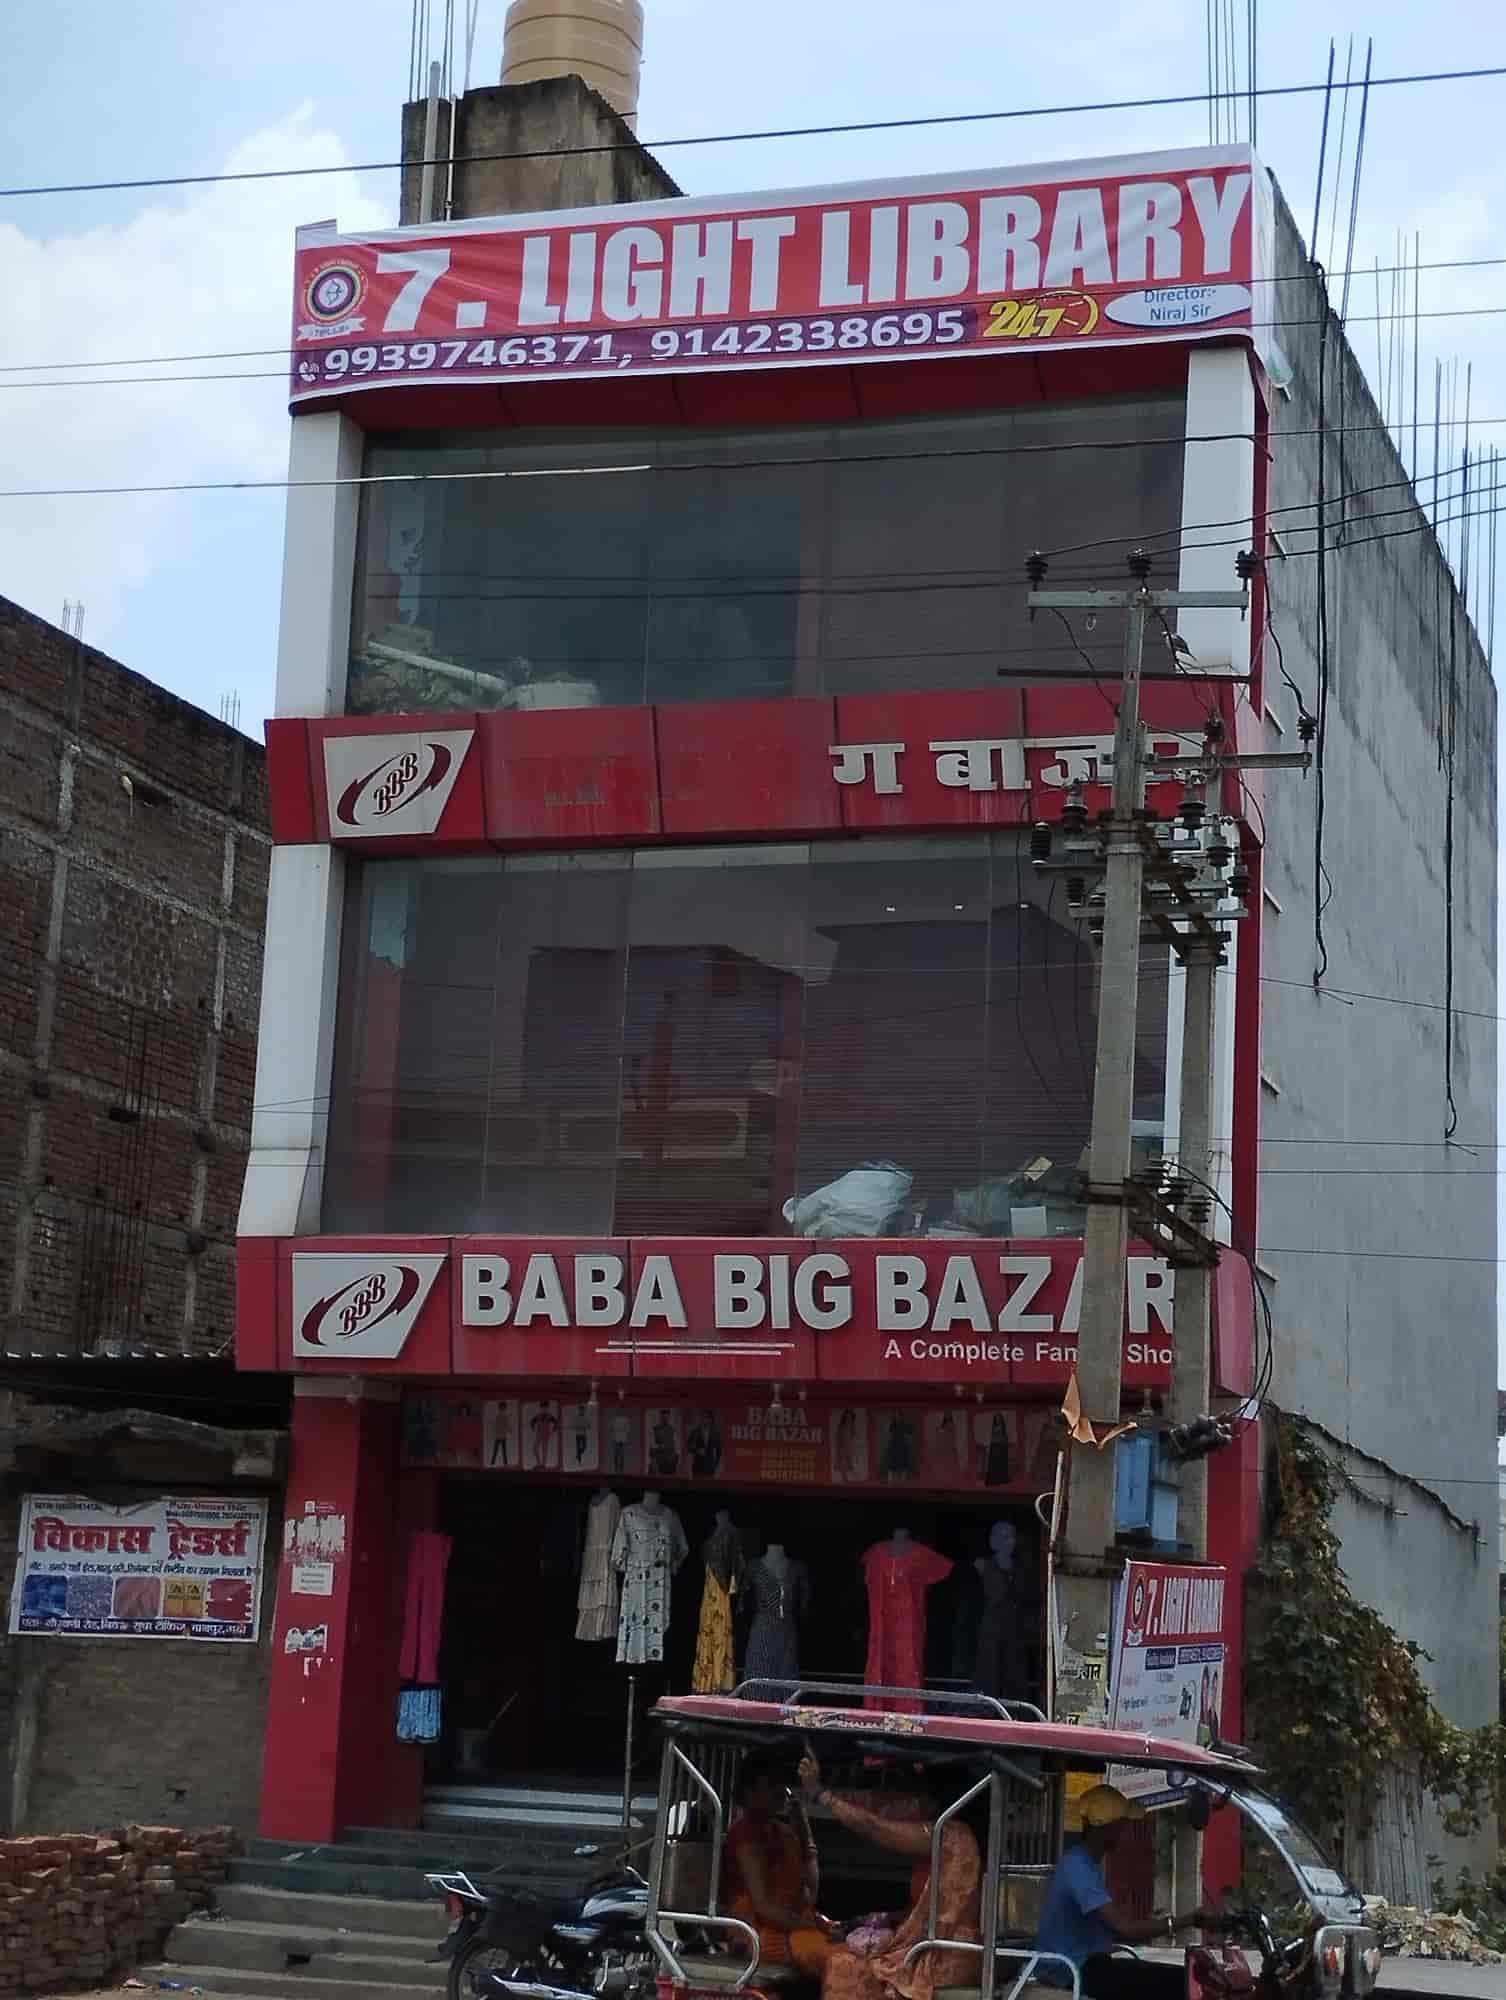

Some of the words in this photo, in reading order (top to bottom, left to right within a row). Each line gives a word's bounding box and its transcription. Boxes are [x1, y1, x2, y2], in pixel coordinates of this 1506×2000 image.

[519, 216, 797, 327] LIGHT
[818, 172, 1252, 308] LIBRARY
[1149, 307, 1187, 322] Niraj
[1191, 303, 1212, 318] Sir
[324, 333, 632, 380] 9939746371,
[650, 310, 965, 362] 9142338695
[462, 1253, 688, 1329] BABA
[714, 1254, 853, 1331] BIG
[884, 1340, 902, 1359] A
[911, 1338, 1025, 1363] Complete
[1127, 1343, 1173, 1364] Sho
[33, 1515, 155, 1553] विकास
